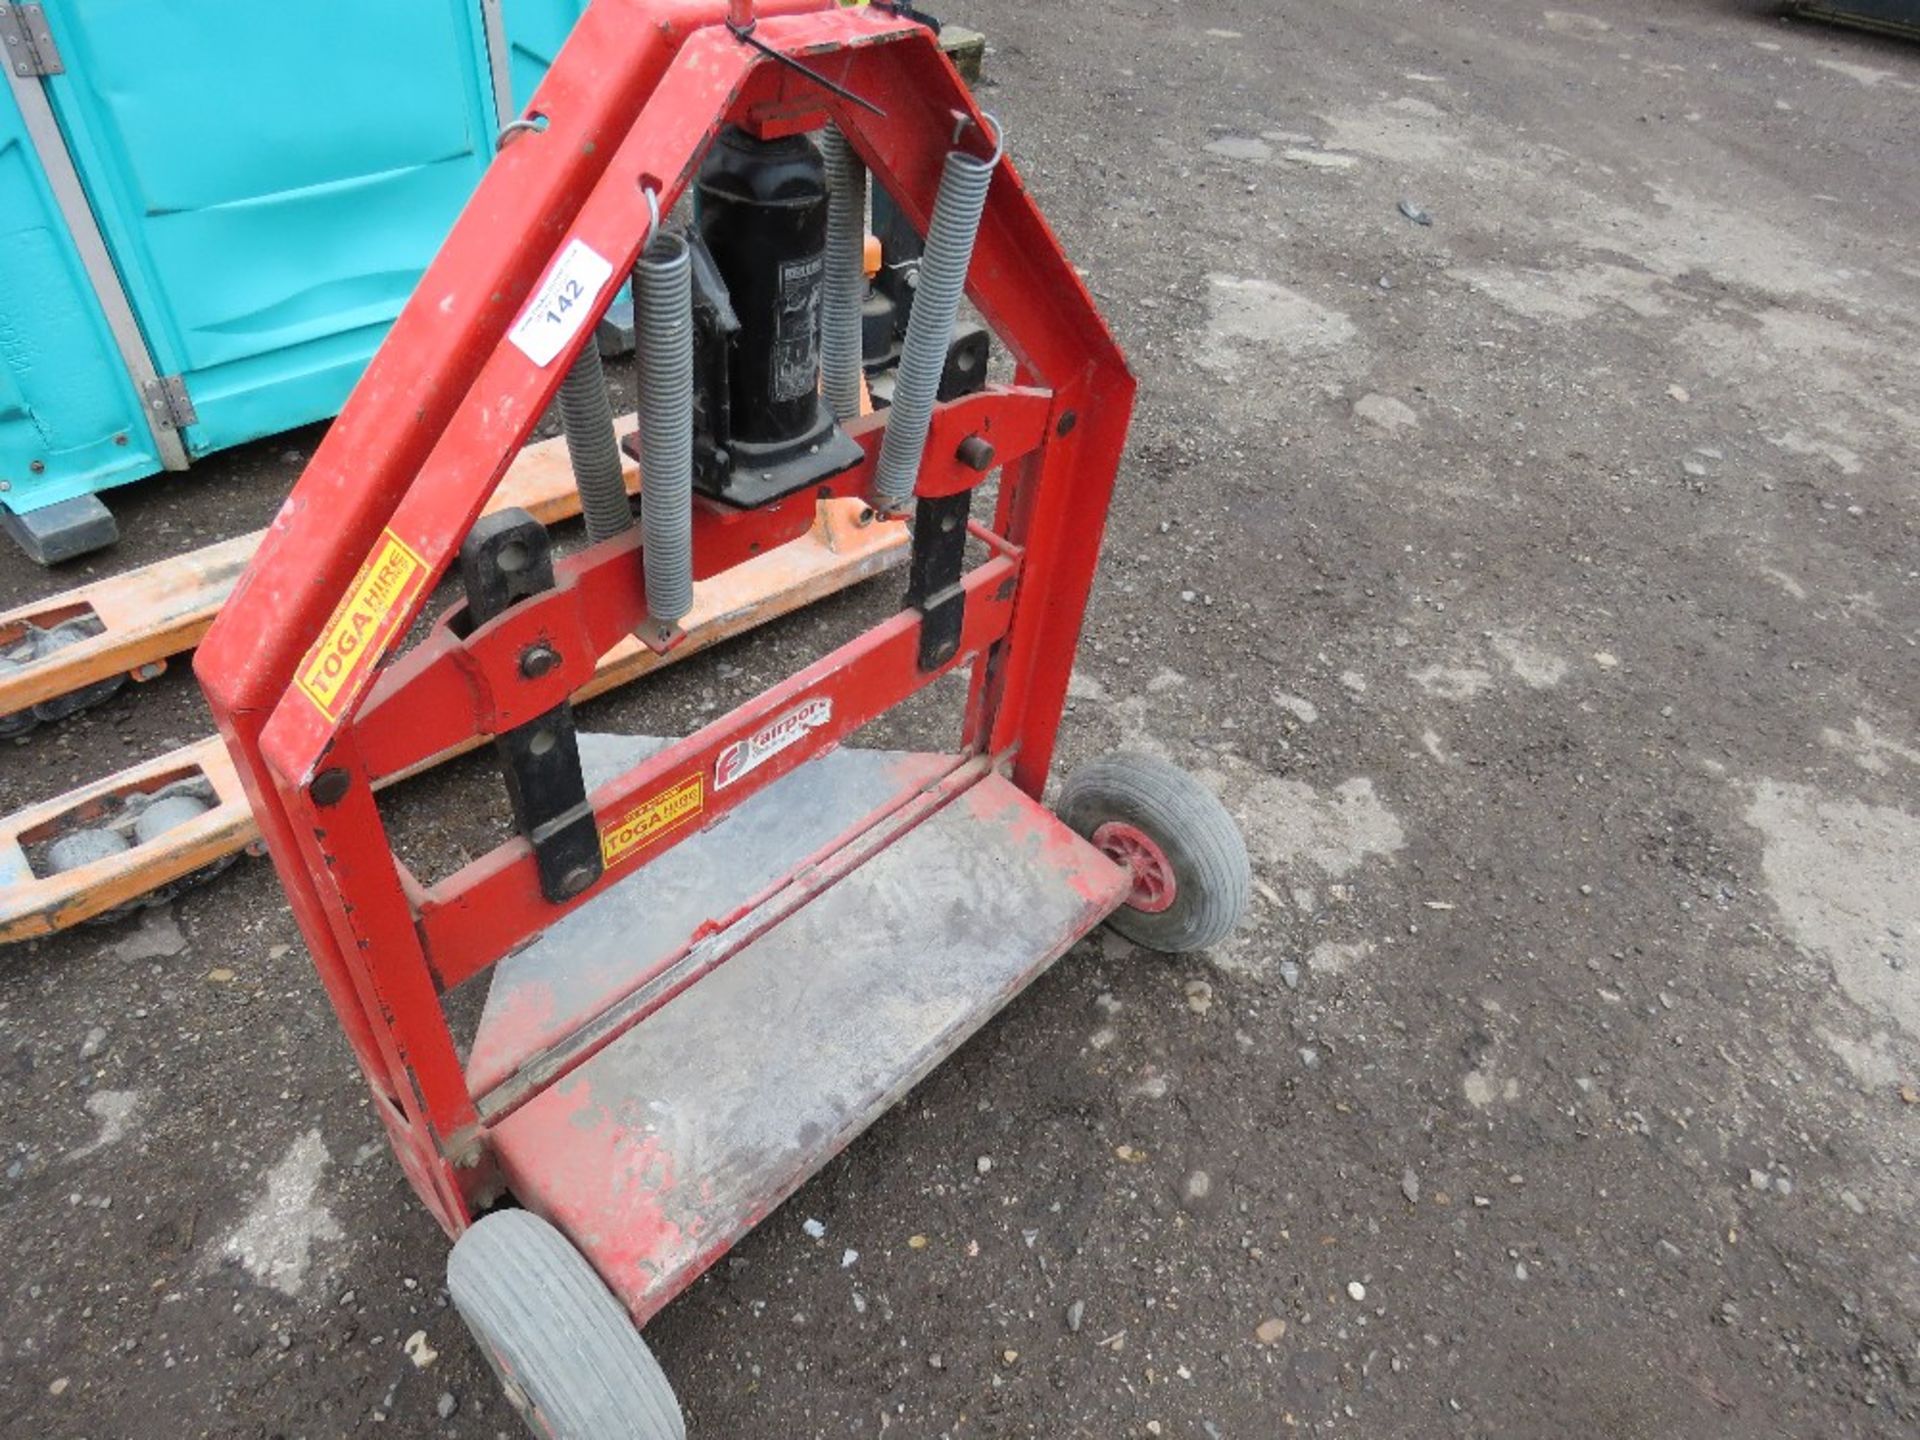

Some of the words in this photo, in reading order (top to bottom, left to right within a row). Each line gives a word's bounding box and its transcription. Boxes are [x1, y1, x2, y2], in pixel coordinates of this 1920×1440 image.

[547, 280, 584, 323] 142
[310, 612, 373, 693] TOGA
[363, 550, 402, 612] HIRE
[608, 813, 662, 850] TOGA
